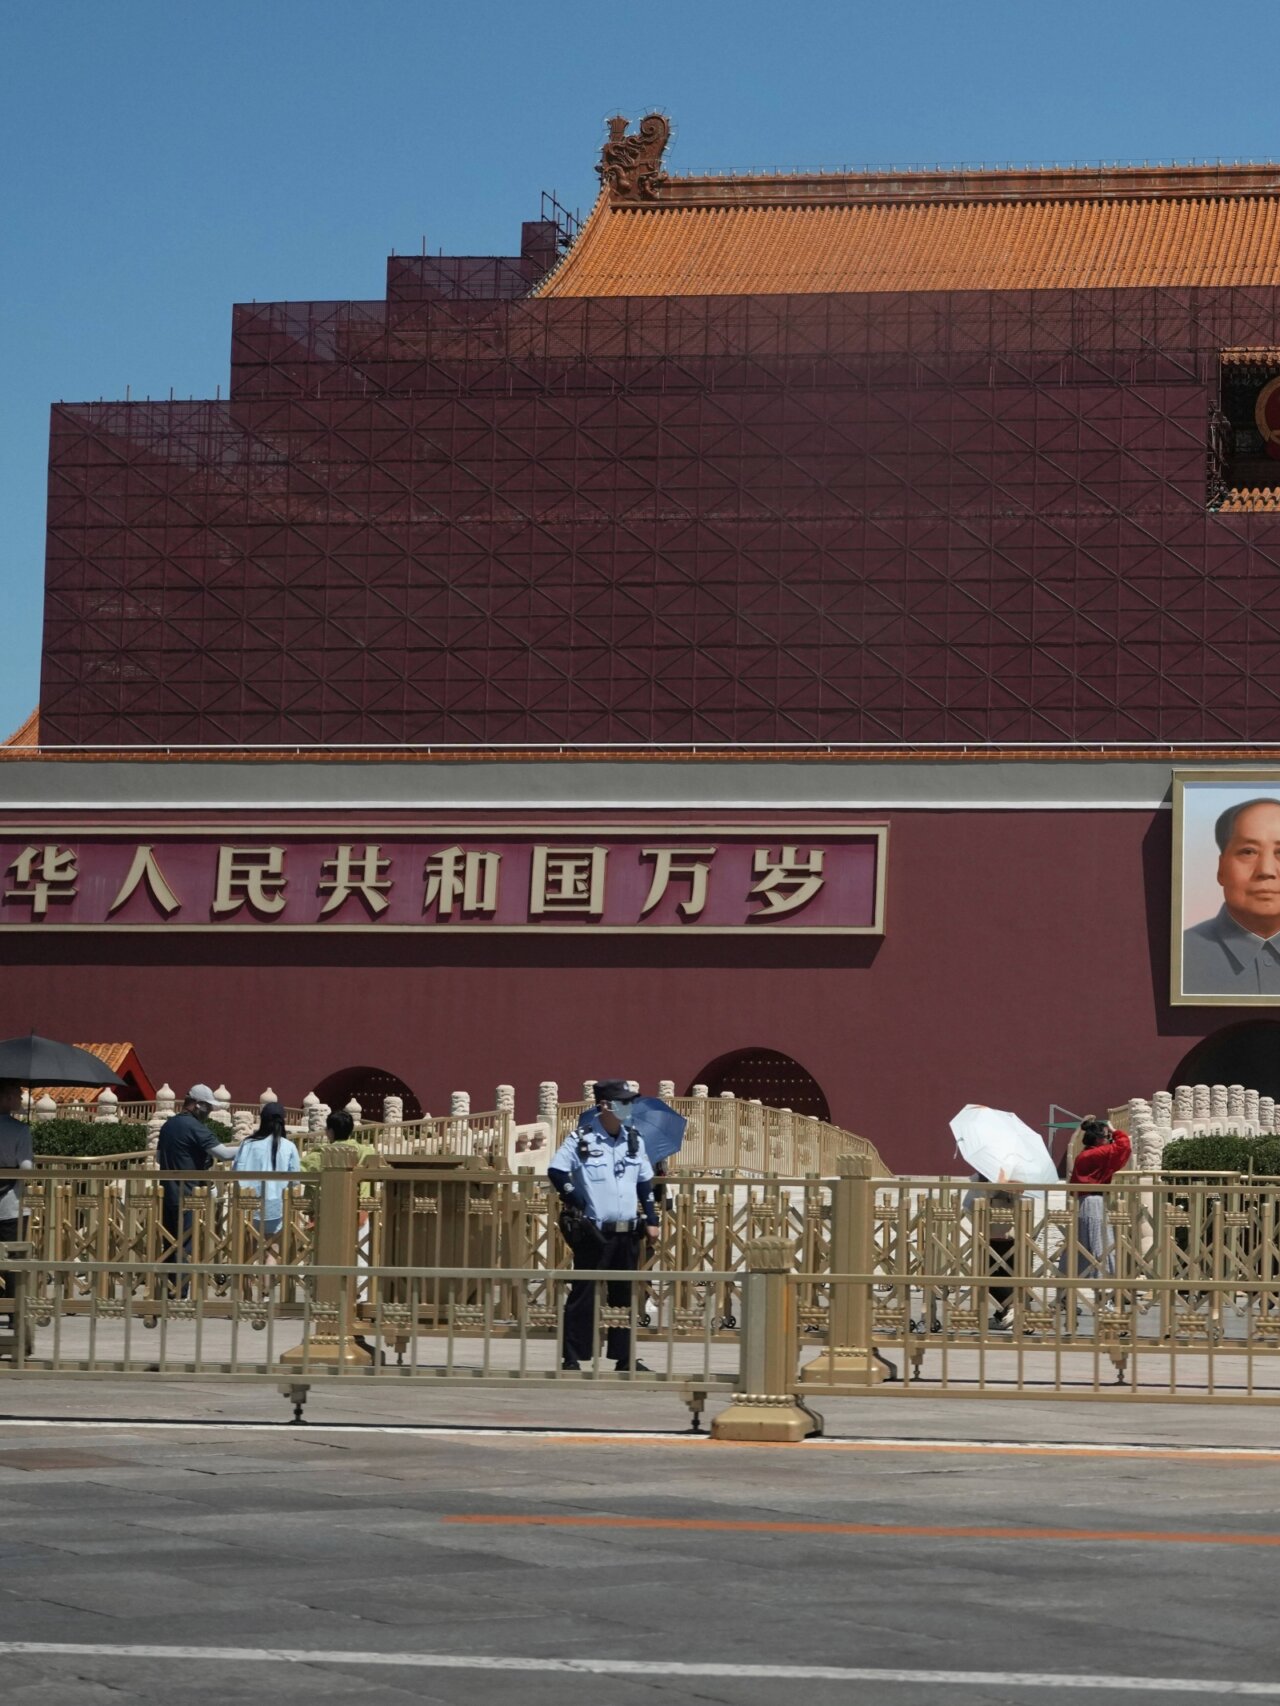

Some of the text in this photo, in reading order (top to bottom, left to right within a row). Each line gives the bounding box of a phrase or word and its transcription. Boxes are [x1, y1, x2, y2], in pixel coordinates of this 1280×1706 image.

[5, 844, 826, 916] 华人民共和国万岁
